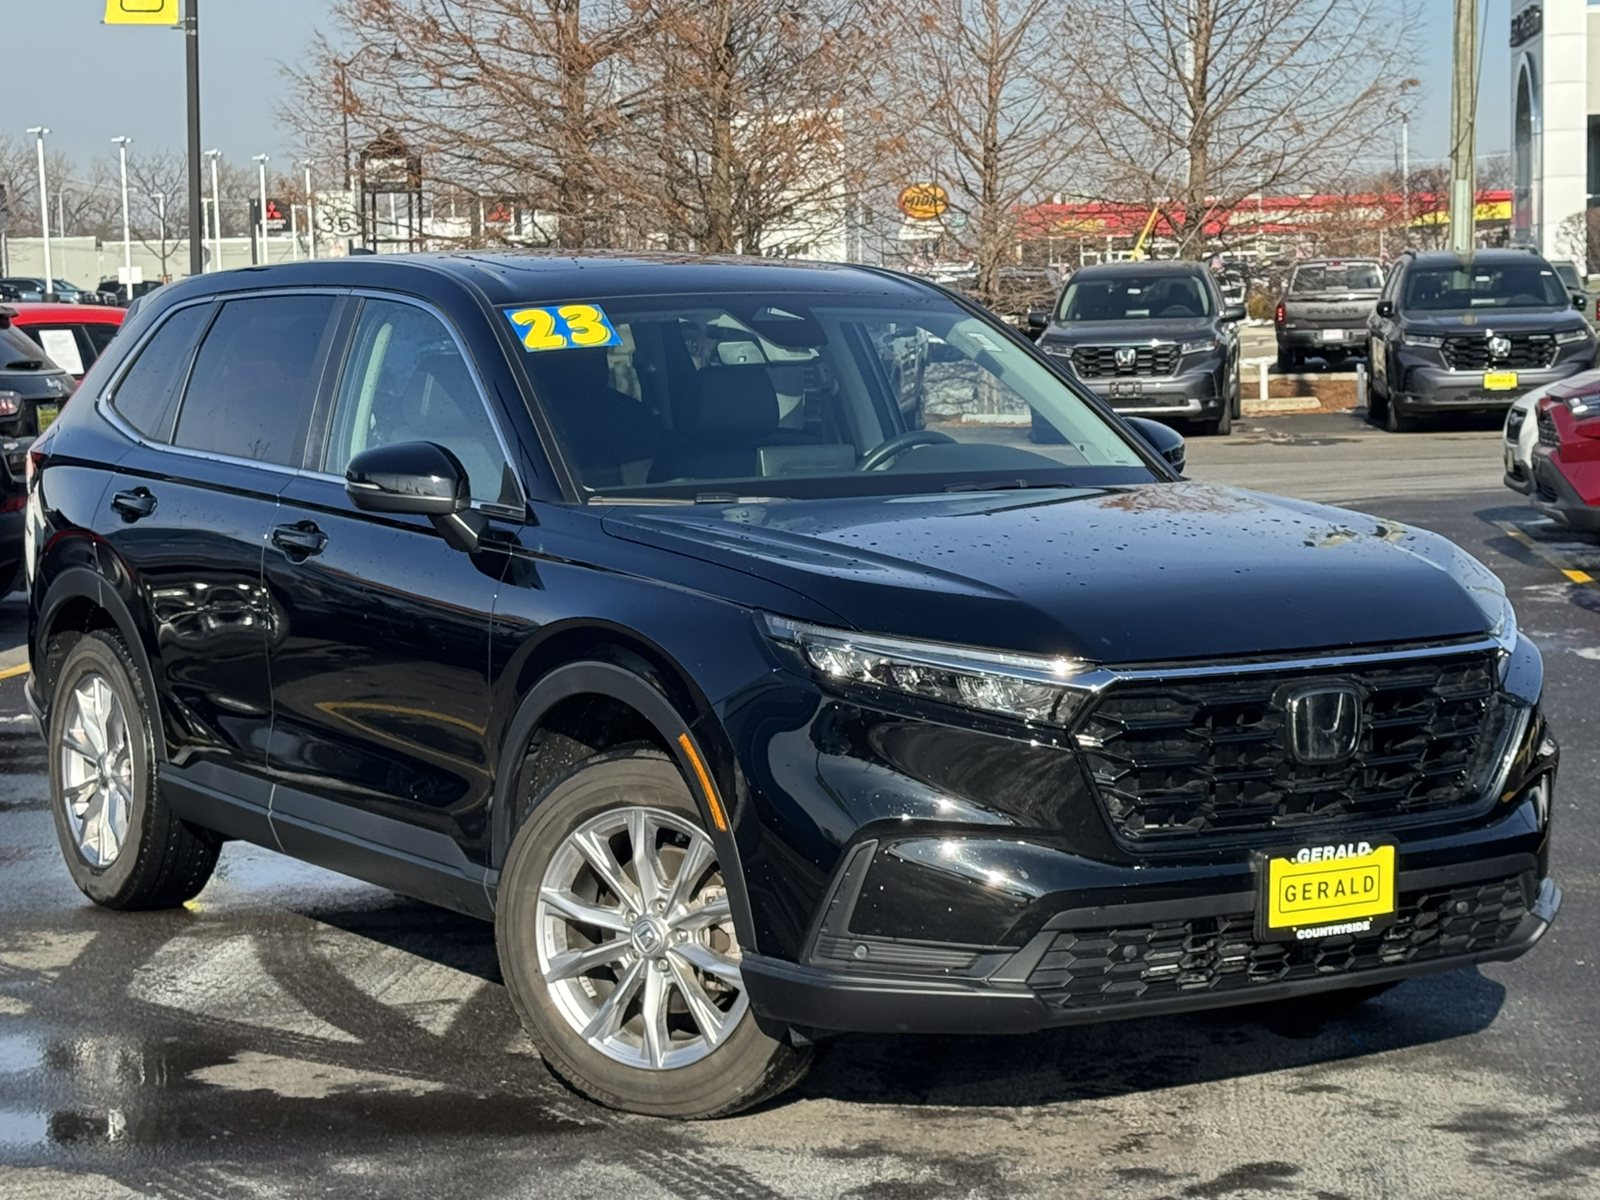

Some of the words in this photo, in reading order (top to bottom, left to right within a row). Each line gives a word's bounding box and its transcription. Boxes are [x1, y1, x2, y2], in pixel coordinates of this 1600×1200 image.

[322, 217, 351, 233] 35
[511, 304, 612, 350] 23
[1296, 841, 1371, 864] GERALD
[1284, 875, 1374, 902] GERALD
[1296, 920, 1370, 940] COUNTRYSIDE
